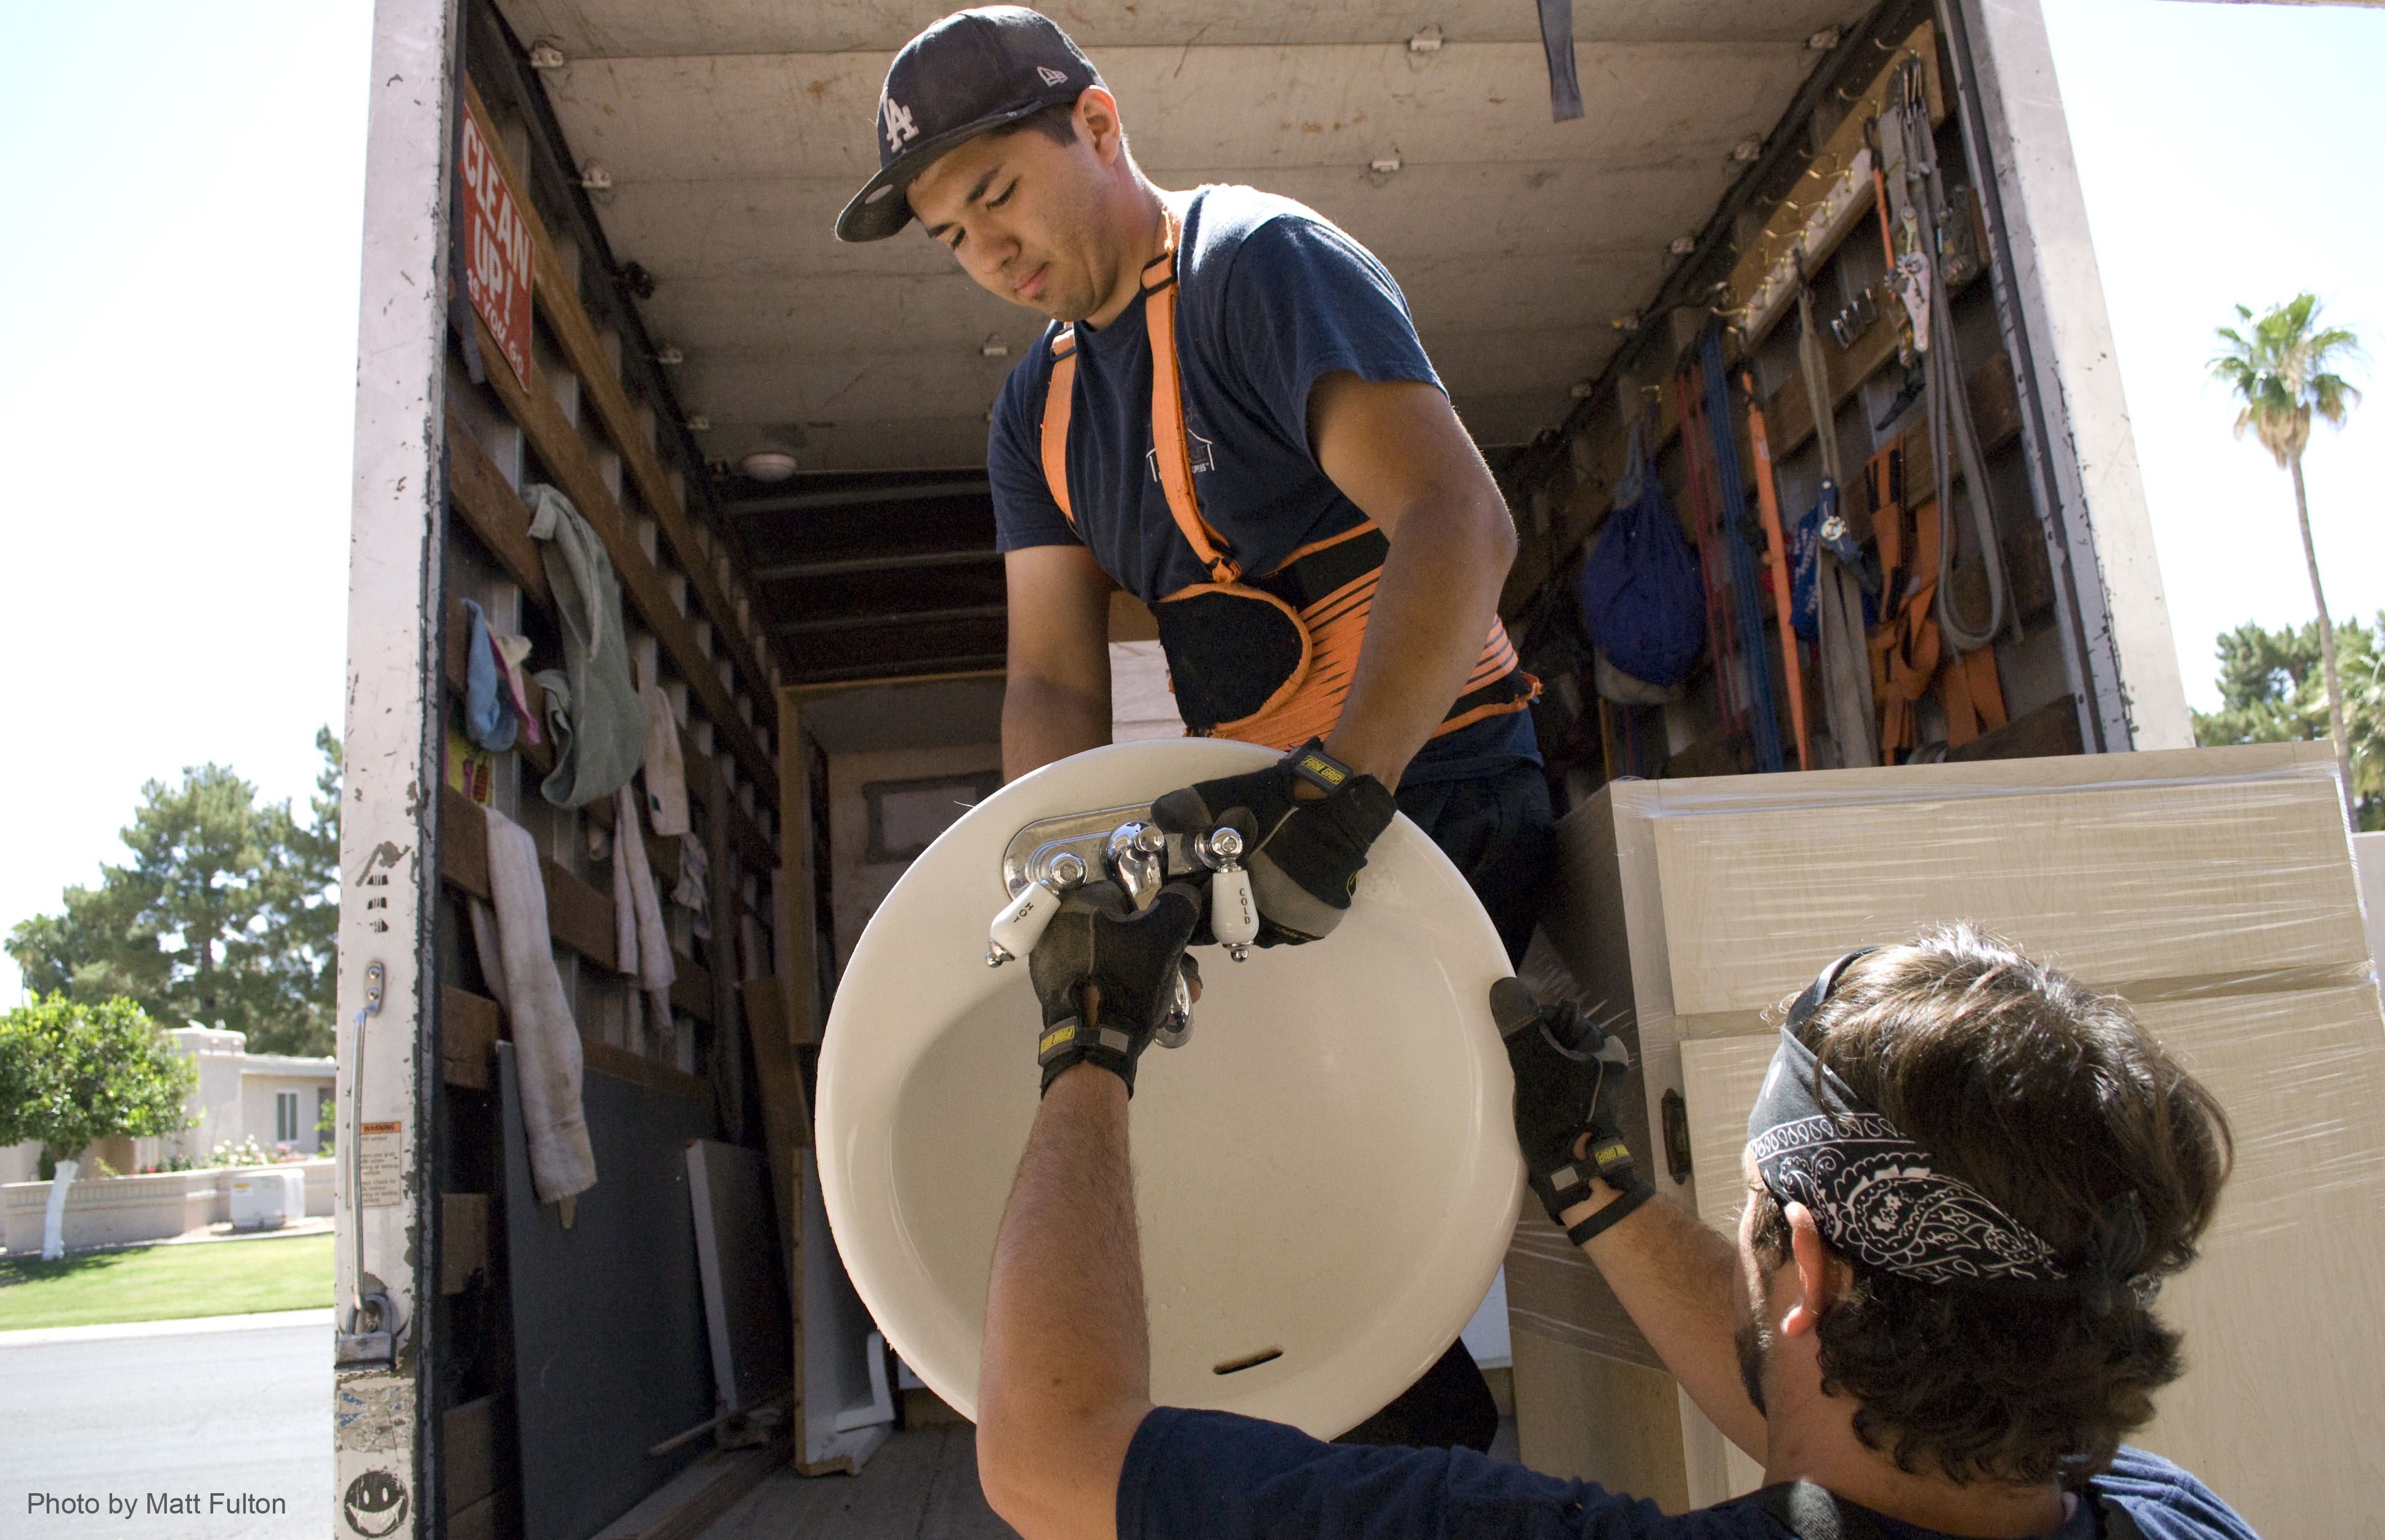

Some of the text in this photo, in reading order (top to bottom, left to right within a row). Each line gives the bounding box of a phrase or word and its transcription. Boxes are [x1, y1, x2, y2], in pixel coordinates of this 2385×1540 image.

[882, 87, 920, 153] LA
[463, 118, 530, 291] CLEAN
[474, 213, 514, 326] UP!
[1303, 757, 1343, 782] FIRM GRIP
[1013, 902, 1034, 923] HOT
[1239, 888, 1250, 925] COLD
[363, 1124, 395, 1132] WARNING
[1598, 1148, 1617, 1163] GRIP
